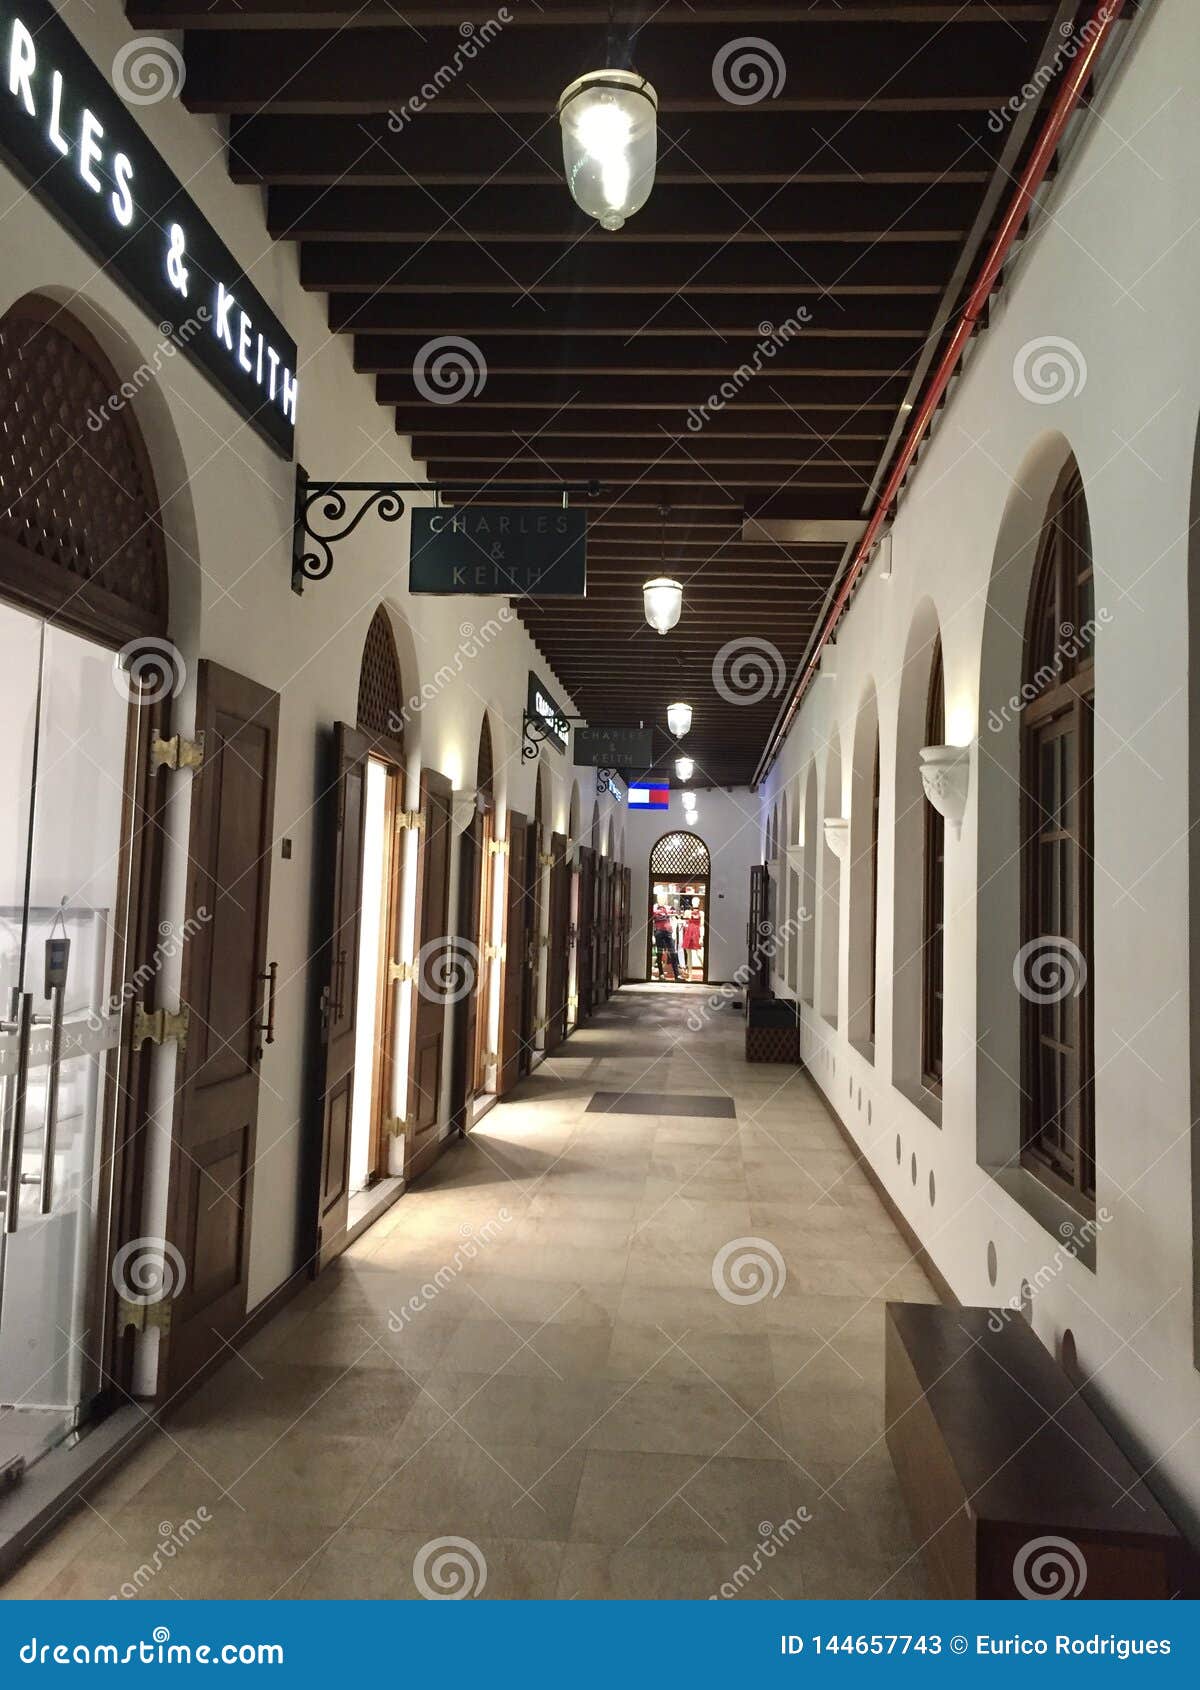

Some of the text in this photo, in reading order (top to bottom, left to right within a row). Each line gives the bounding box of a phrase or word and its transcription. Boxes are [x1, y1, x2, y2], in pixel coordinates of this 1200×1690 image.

[167, 223, 188, 298] &
[213, 282, 298, 425] KEITH
[429, 515, 568, 534] CHARLES
[490, 541, 505, 559] &
[453, 565, 544, 585] KEITH
[592, 753, 633, 764] KEITH
